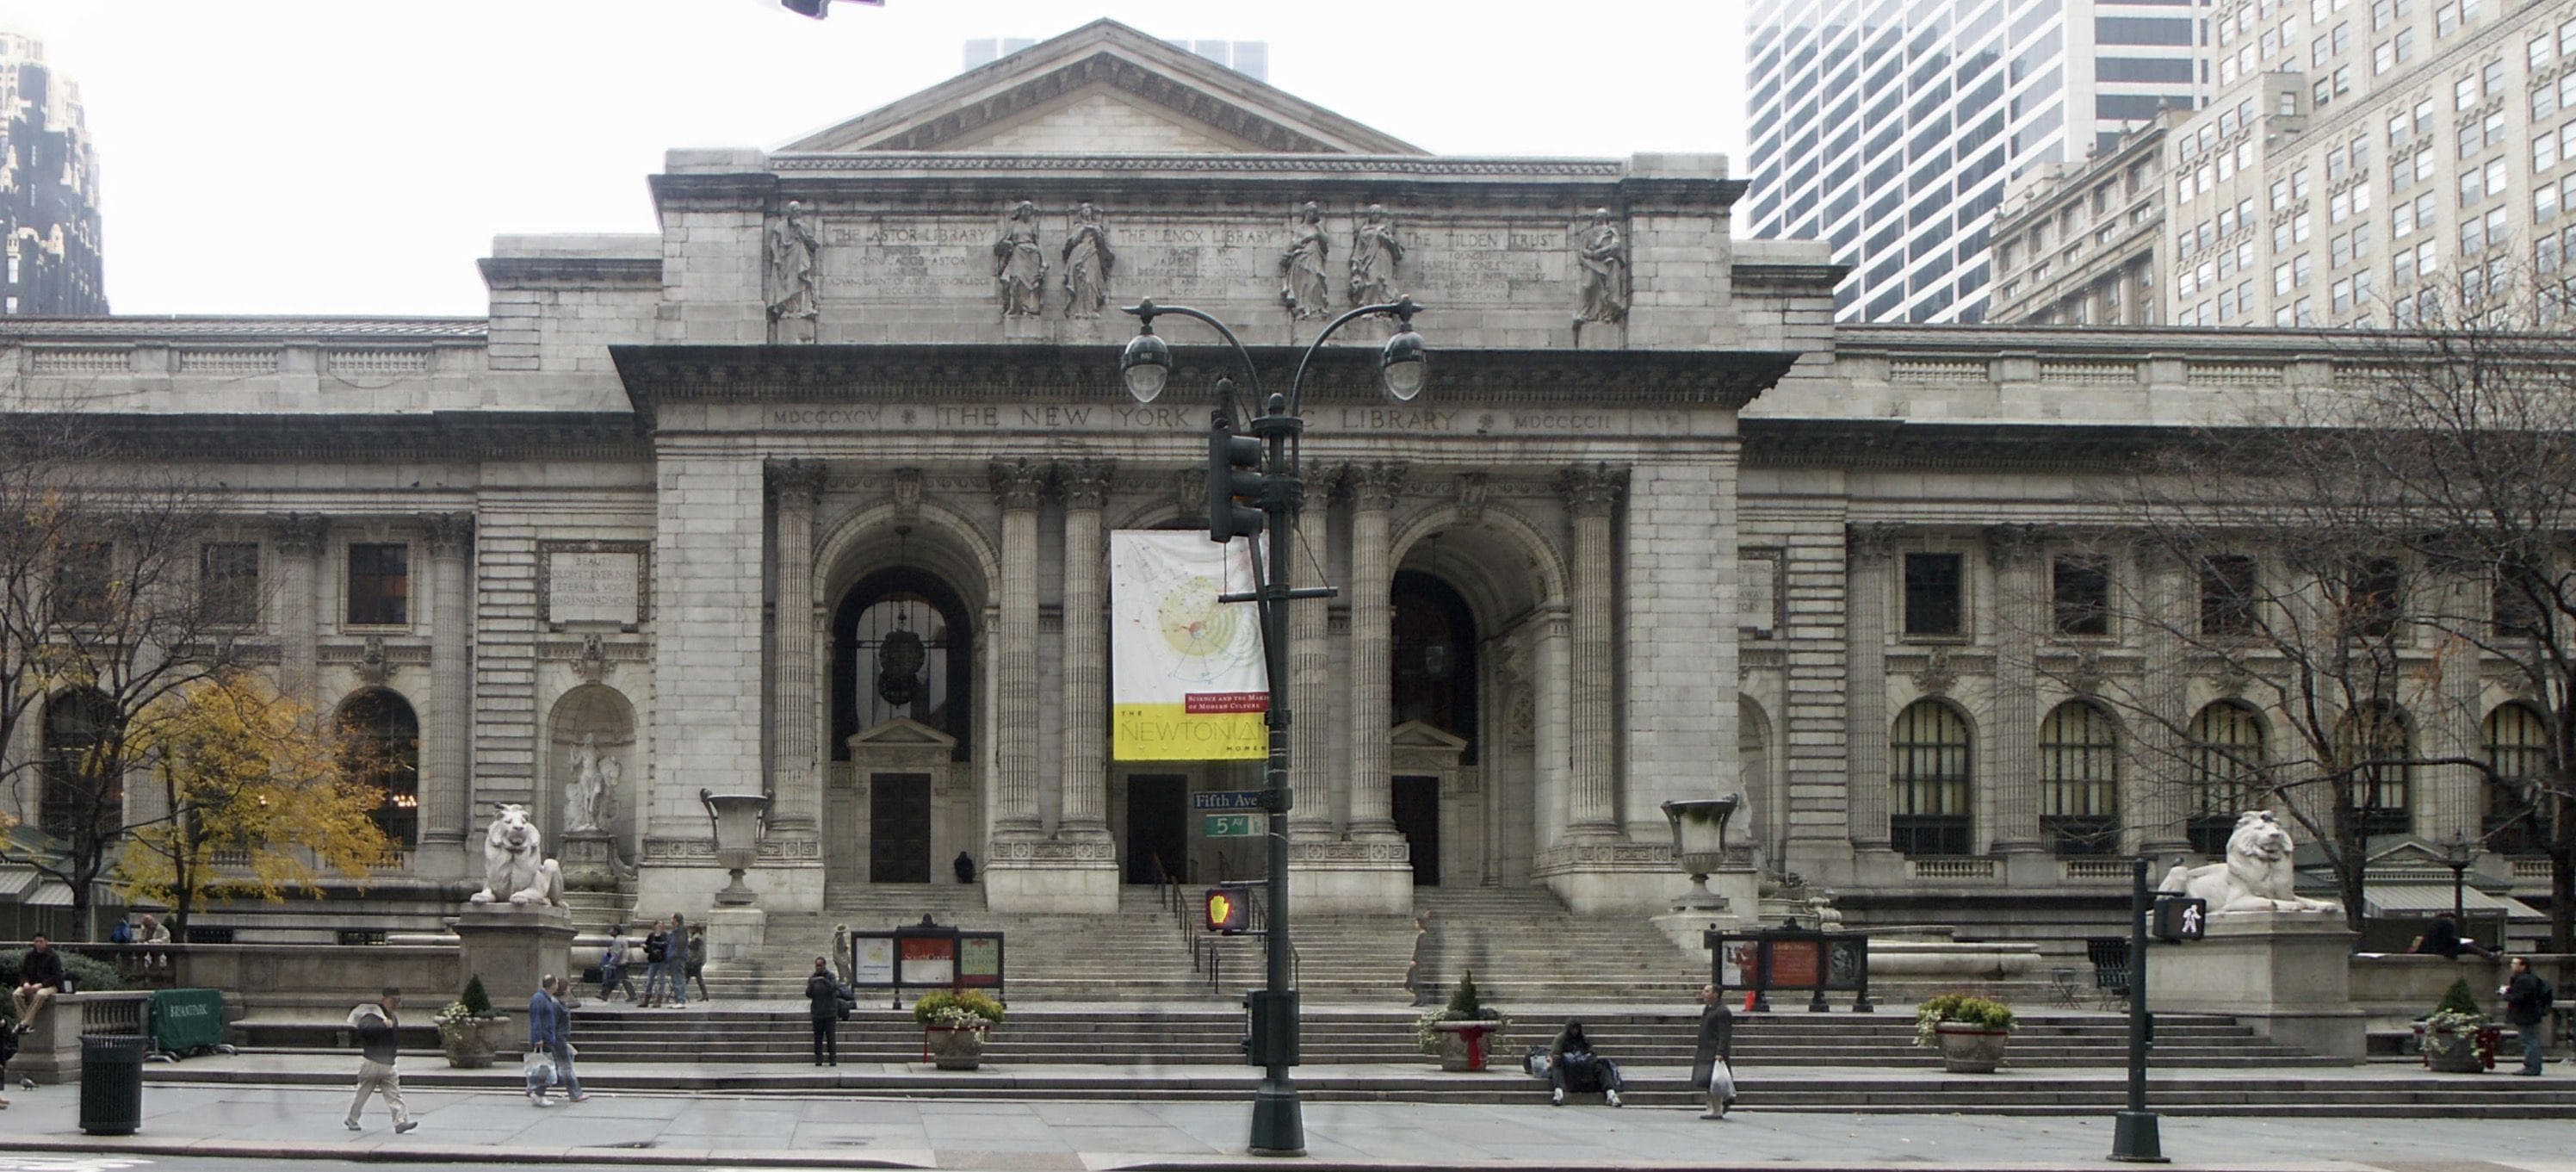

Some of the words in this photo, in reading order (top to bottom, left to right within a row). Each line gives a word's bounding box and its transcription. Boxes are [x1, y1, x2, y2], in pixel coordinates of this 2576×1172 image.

[832, 228, 859, 242] THE
[870, 228, 916, 242] ASTOR
[926, 228, 988, 242] LIBRARY
[1119, 228, 1147, 243] THE
[1155, 228, 1204, 243] LENOX
[1212, 228, 1275, 243] LIBRARY
[1405, 232, 1431, 247] THE
[1445, 233, 1499, 248] TILDEN
[1509, 233, 1558, 248] TRUST
[774, 409, 880, 425] MDCCCXCV
[939, 408, 999, 427] THE
[1021, 408, 1093, 426] NEW
[1118, 408, 1192, 427] YORK
[1341, 409, 1458, 430] LIBRARY
[1514, 413, 1610, 429] MDCCCCII
[576, 557, 613, 566] BEAUTY
[1196, 794, 1229, 807] Fifth
[1235, 794, 1258, 807] Ave
[1217, 817, 1229, 834] 5
